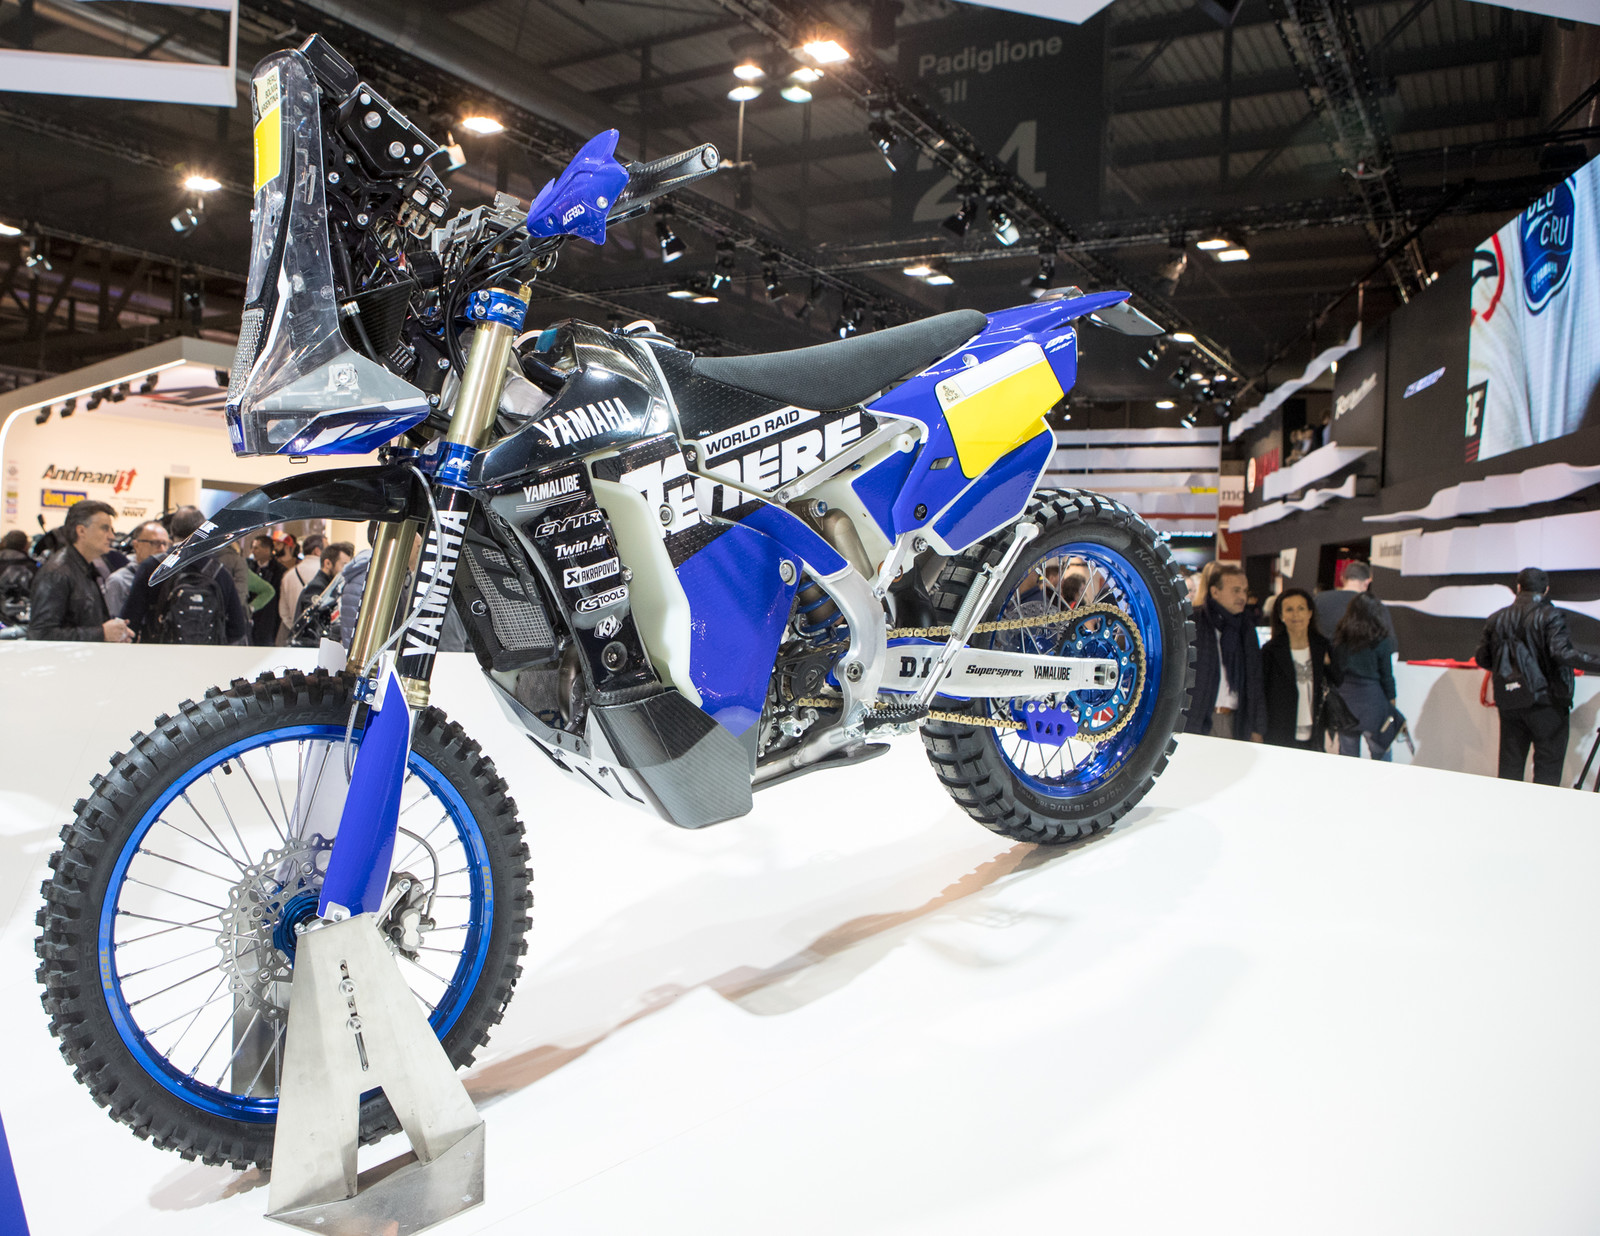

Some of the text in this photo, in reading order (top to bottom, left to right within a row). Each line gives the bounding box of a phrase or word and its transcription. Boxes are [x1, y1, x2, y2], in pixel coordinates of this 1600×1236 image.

[918, 35, 1063, 78] Padiglione
[561, 200, 586, 226] ACERBIS
[1540, 214, 1570, 247] CRU
[532, 396, 636, 450] YAMAHA
[705, 409, 800, 456] WORLD RAID
[42, 463, 119, 485] Andreani
[522, 472, 581, 503] YAMALUBE
[534, 508, 602, 539] GYTR
[554, 533, 609, 559] Twin Air
[402, 510, 469, 657] YAMAHA
[965, 664, 1025, 678] Supersprox
[1033, 664, 1073, 681] YAMALUBE
[481, 865, 493, 904] EXCEL
[100, 946, 112, 990] EXCEL
